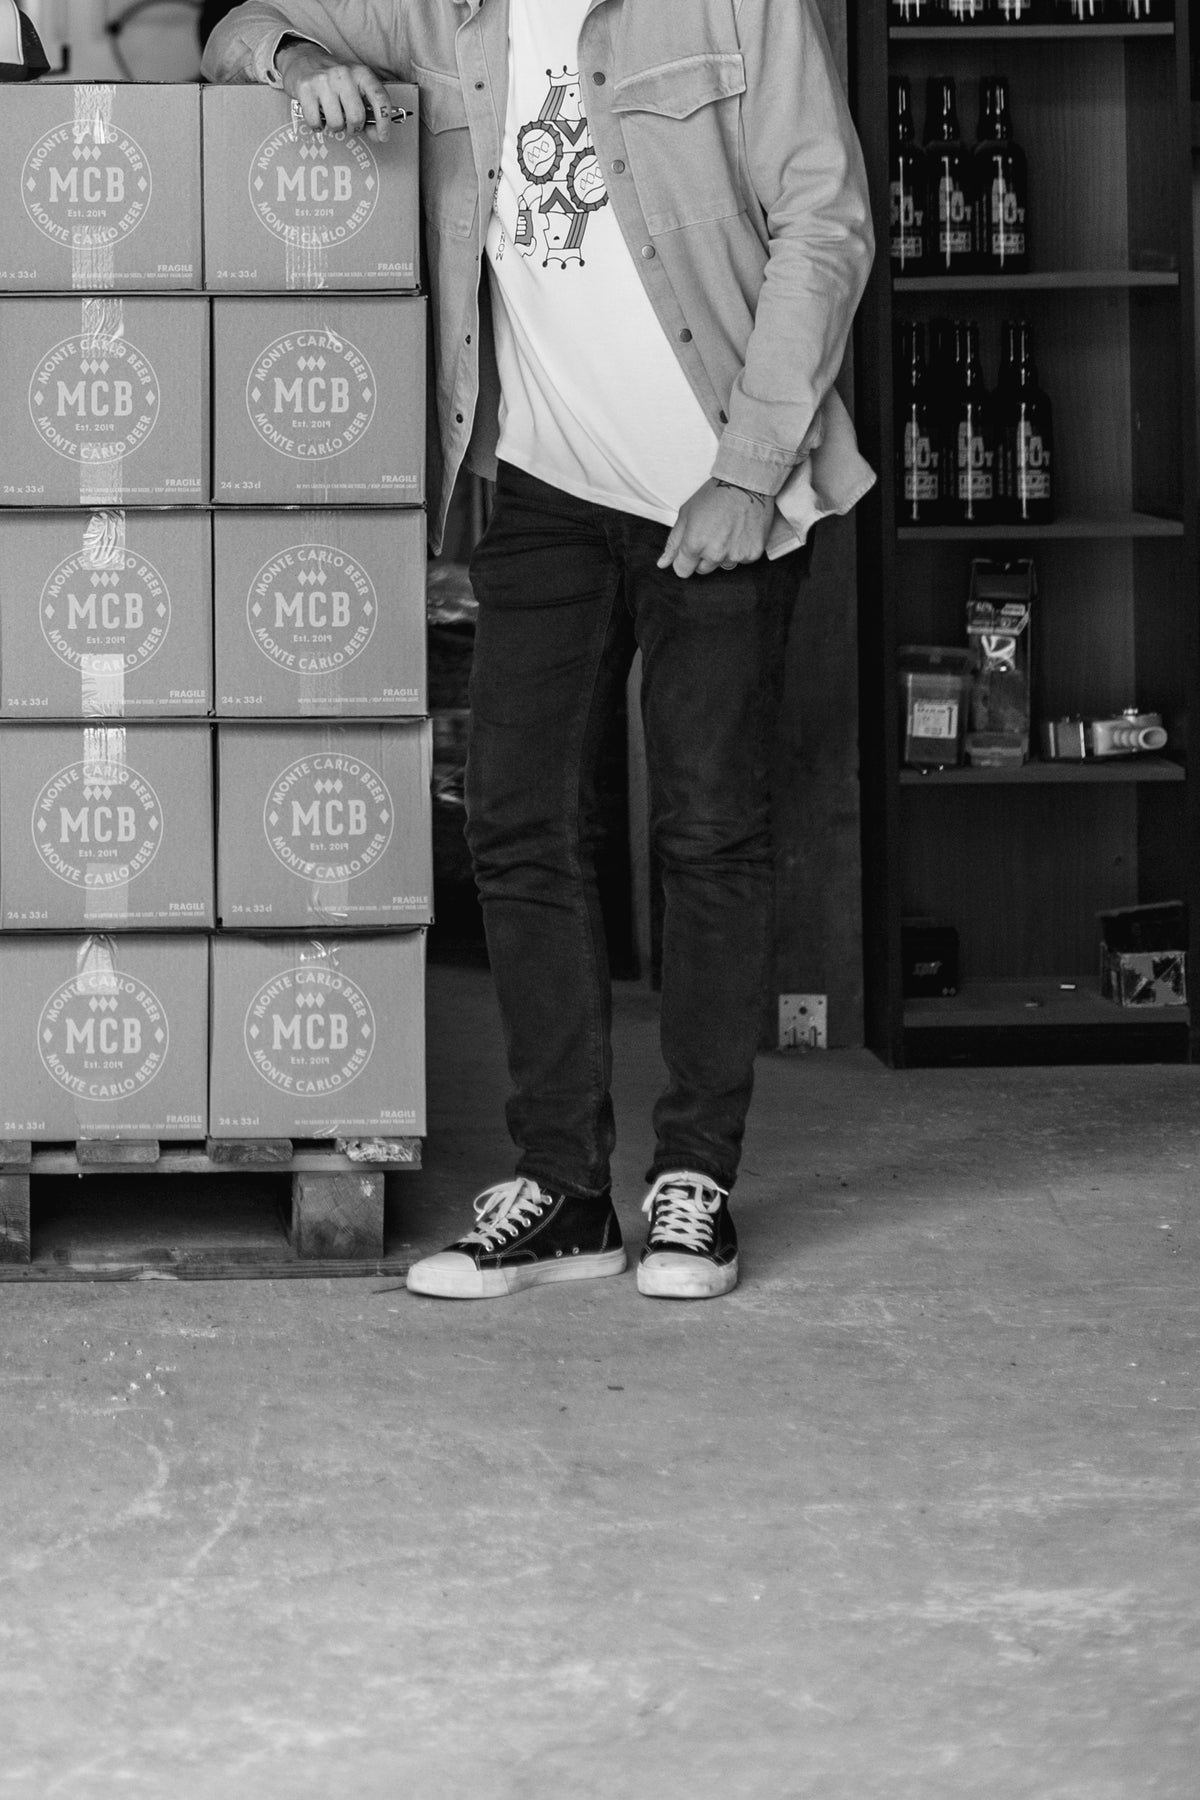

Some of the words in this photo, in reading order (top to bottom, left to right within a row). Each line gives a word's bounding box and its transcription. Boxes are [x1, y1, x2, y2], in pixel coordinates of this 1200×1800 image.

[49, 167, 124, 202] MCB
[276, 166, 352, 201] MCB
[67, 209, 84, 217] Est.
[87, 209, 106, 217] 2019
[295, 208, 312, 216] Est.
[315, 208, 334, 216] 2019
[158, 264, 193, 272] FRAGILE
[378, 263, 413, 271] FRAGILE
[255, 339, 294, 382] MONTE
[344, 351, 368, 382] BEER
[56, 381, 132, 416] MCB
[274, 377, 349, 413] MCB
[255, 413, 295, 451] MONTE
[297, 438, 342, 455] CARLO
[343, 412, 368, 442] BEER
[292, 420, 308, 428] Est.
[311, 420, 331, 428] 2019
[166, 479, 201, 487] FRAGILE
[382, 475, 417, 483] FRAGILE
[255, 554, 294, 596] MONTE
[297, 550, 344, 567] CARLO
[345, 565, 369, 596] BEER
[67, 593, 143, 629] MCB
[274, 592, 350, 627] MCB
[86, 636, 103, 644] Est.
[106, 636, 125, 644] 2019
[256, 627, 296, 666] MONTE
[299, 652, 343, 669] CARLO
[344, 626, 369, 656] BEER
[293, 634, 309, 642] Est.
[312, 634, 332, 642] 2019
[170, 690, 205, 698] FRAGILE
[383, 688, 418, 696] FRAGILE
[272, 763, 310, 805] MONTE
[314, 759, 360, 776] CARLO
[361, 773, 385, 804] BEER
[59, 807, 136, 842] MCB
[291, 800, 366, 836] MCB
[78, 849, 95, 857] Est.
[98, 849, 118, 857] 2019
[273, 836, 313, 874] MONTE
[316, 860, 361, 877] CARLO
[361, 833, 386, 863] BEER
[310, 843, 326, 851] Est.
[330, 842, 349, 850] 2019
[169, 903, 204, 911] FRAGILE
[393, 896, 428, 904] FRAGILE
[253, 977, 292, 1019] MONTE
[295, 973, 342, 990] CARLO
[343, 988, 367, 1018] BEER
[65, 1018, 141, 1054] MCB
[272, 1014, 348, 1049] MCB
[253, 1049, 293, 1087] MONTE
[296, 1074, 341, 1091] CARLO
[342, 1048, 367, 1078] BEER
[291, 1056, 307, 1064] Est.
[310, 1056, 330, 1064] 2019
[167, 1115, 202, 1123] FRAGILE
[381, 1110, 416, 1118] FRAGILE
